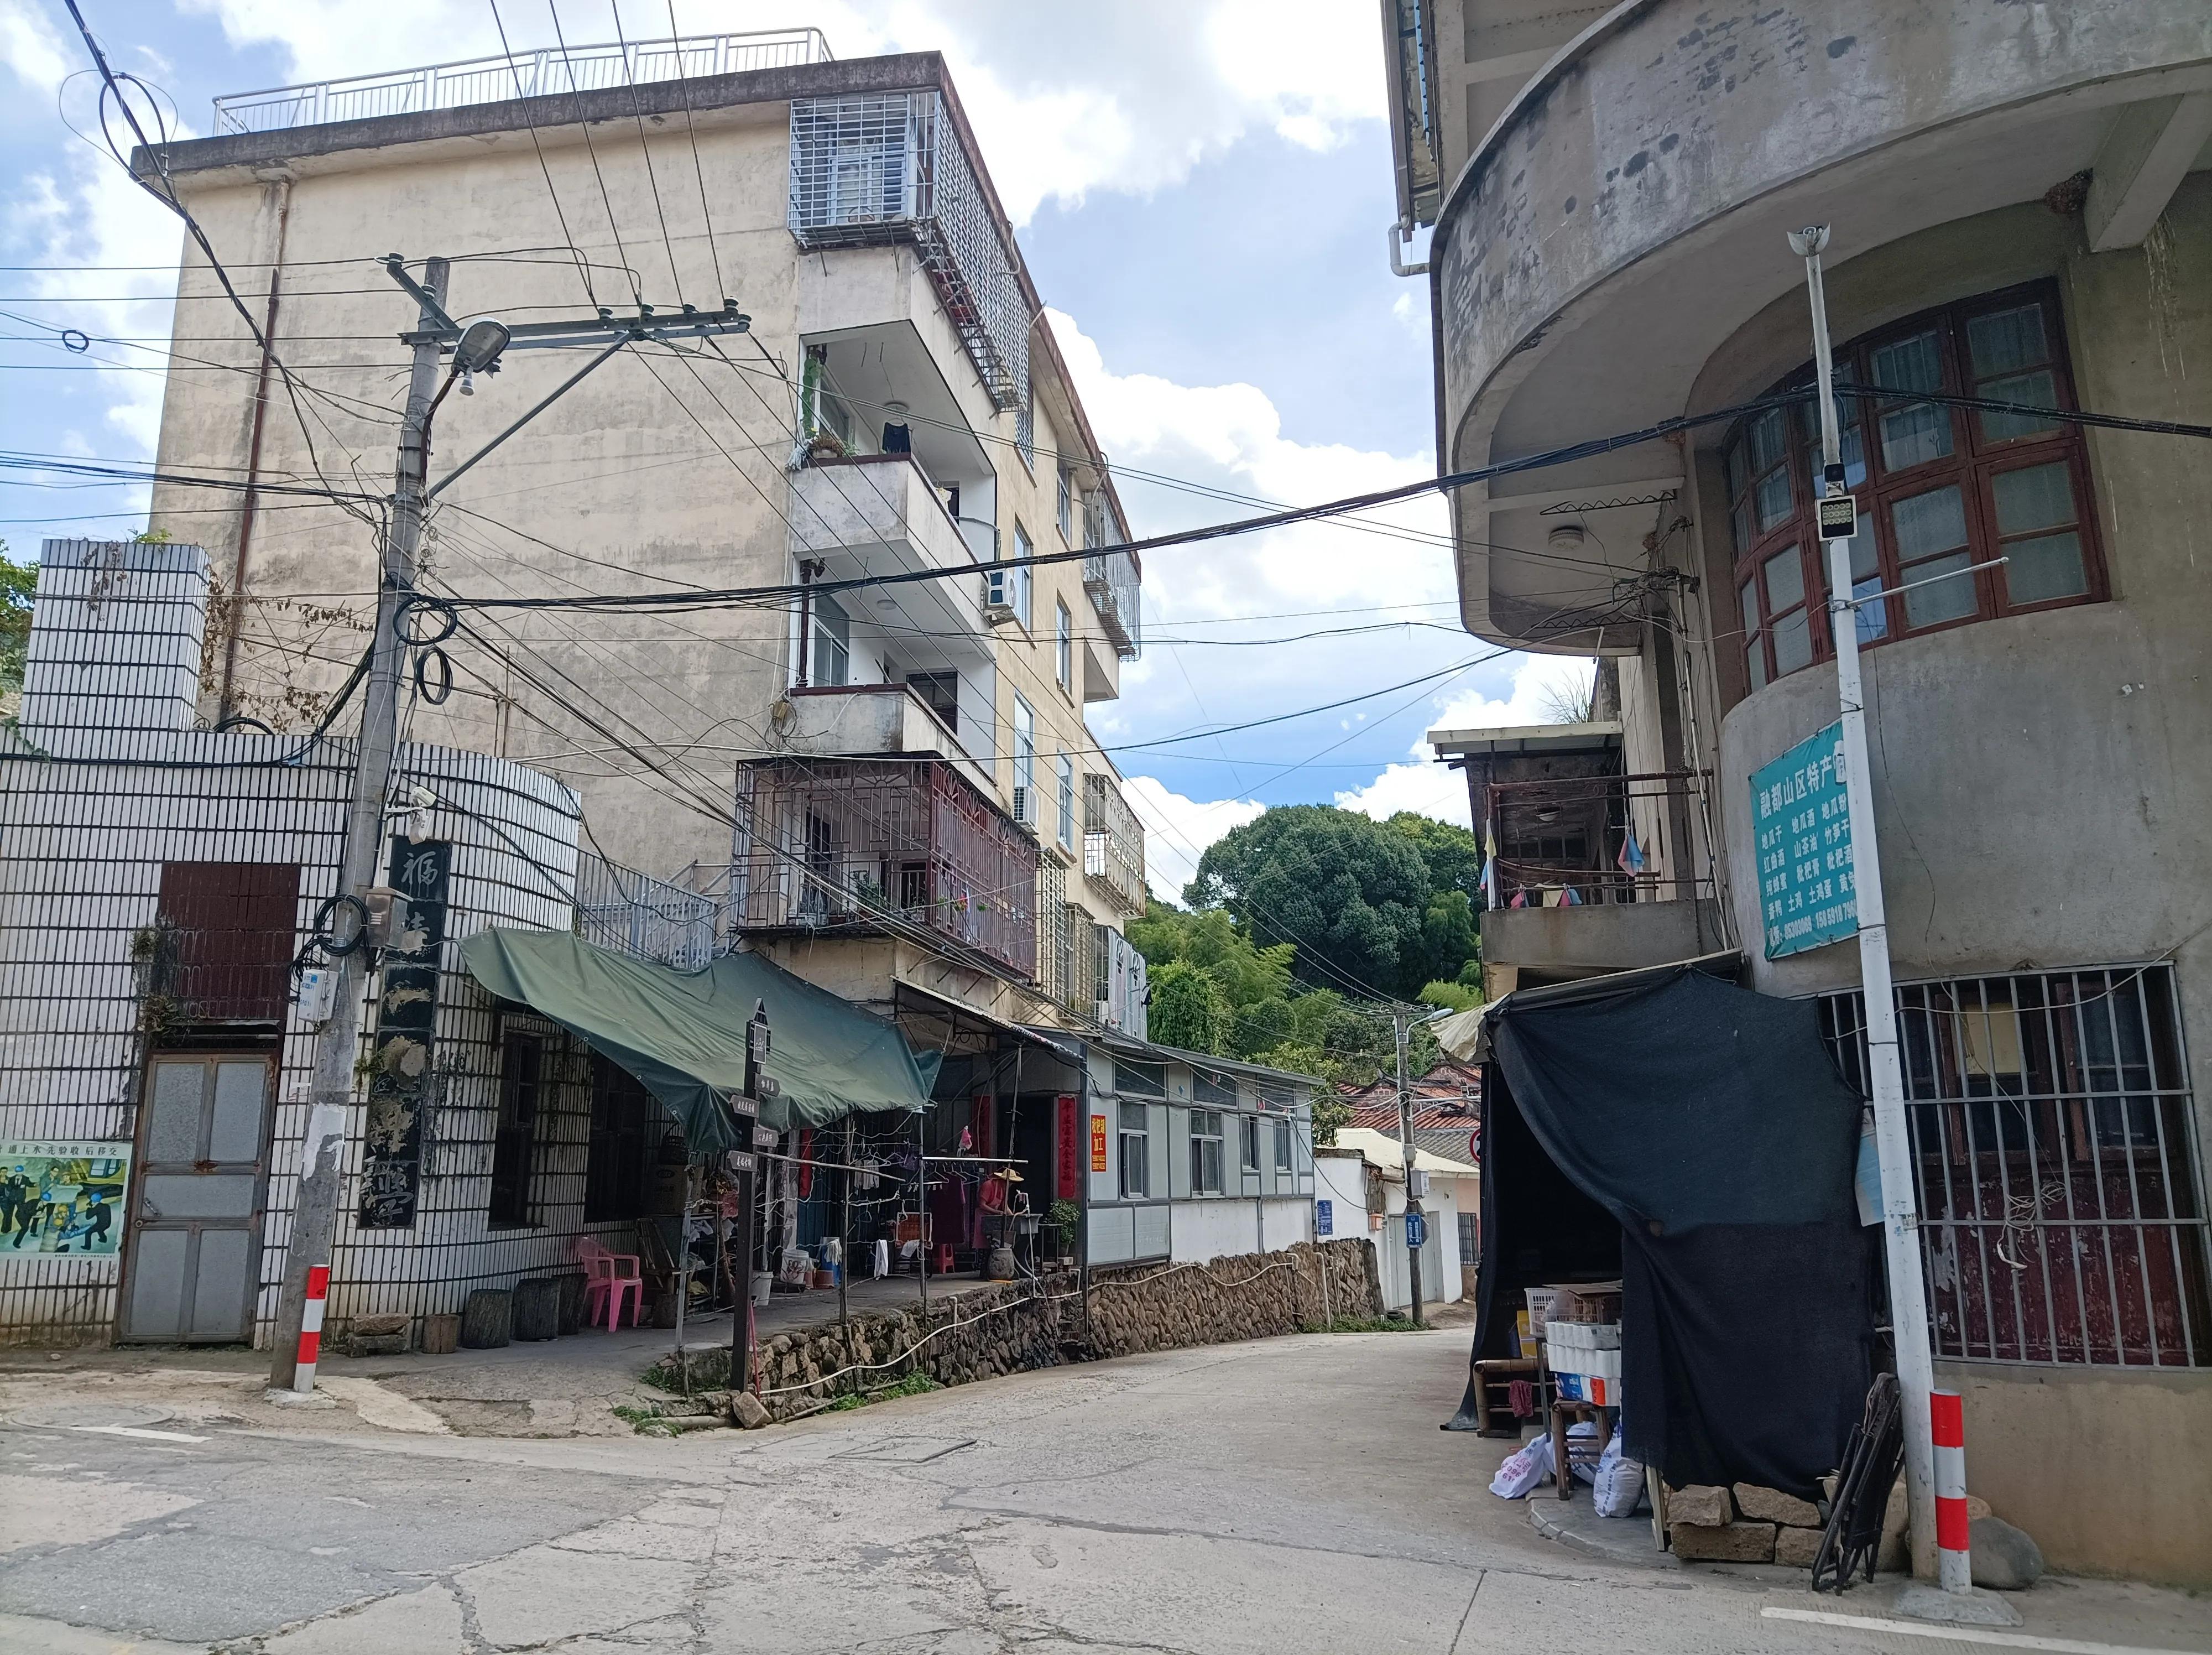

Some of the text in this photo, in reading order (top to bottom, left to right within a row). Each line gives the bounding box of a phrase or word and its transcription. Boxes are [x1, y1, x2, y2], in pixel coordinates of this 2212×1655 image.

[1760, 755, 1836, 820] 融都山区特产
[1762, 793, 1847, 850] 地瓜干 地瓜酒 地瓜粉
[401, 851, 438, 885] 福
[1764, 818, 1850, 874] 红曲酒 山茶油 竹笋干
[1797, 858, 1820, 883] 枇杷膏
[1827, 844, 1853, 871] 枇杷酒
[1788, 891, 1803, 912] 土鸡
[1809, 878, 1833, 904] 土鸡蛋
